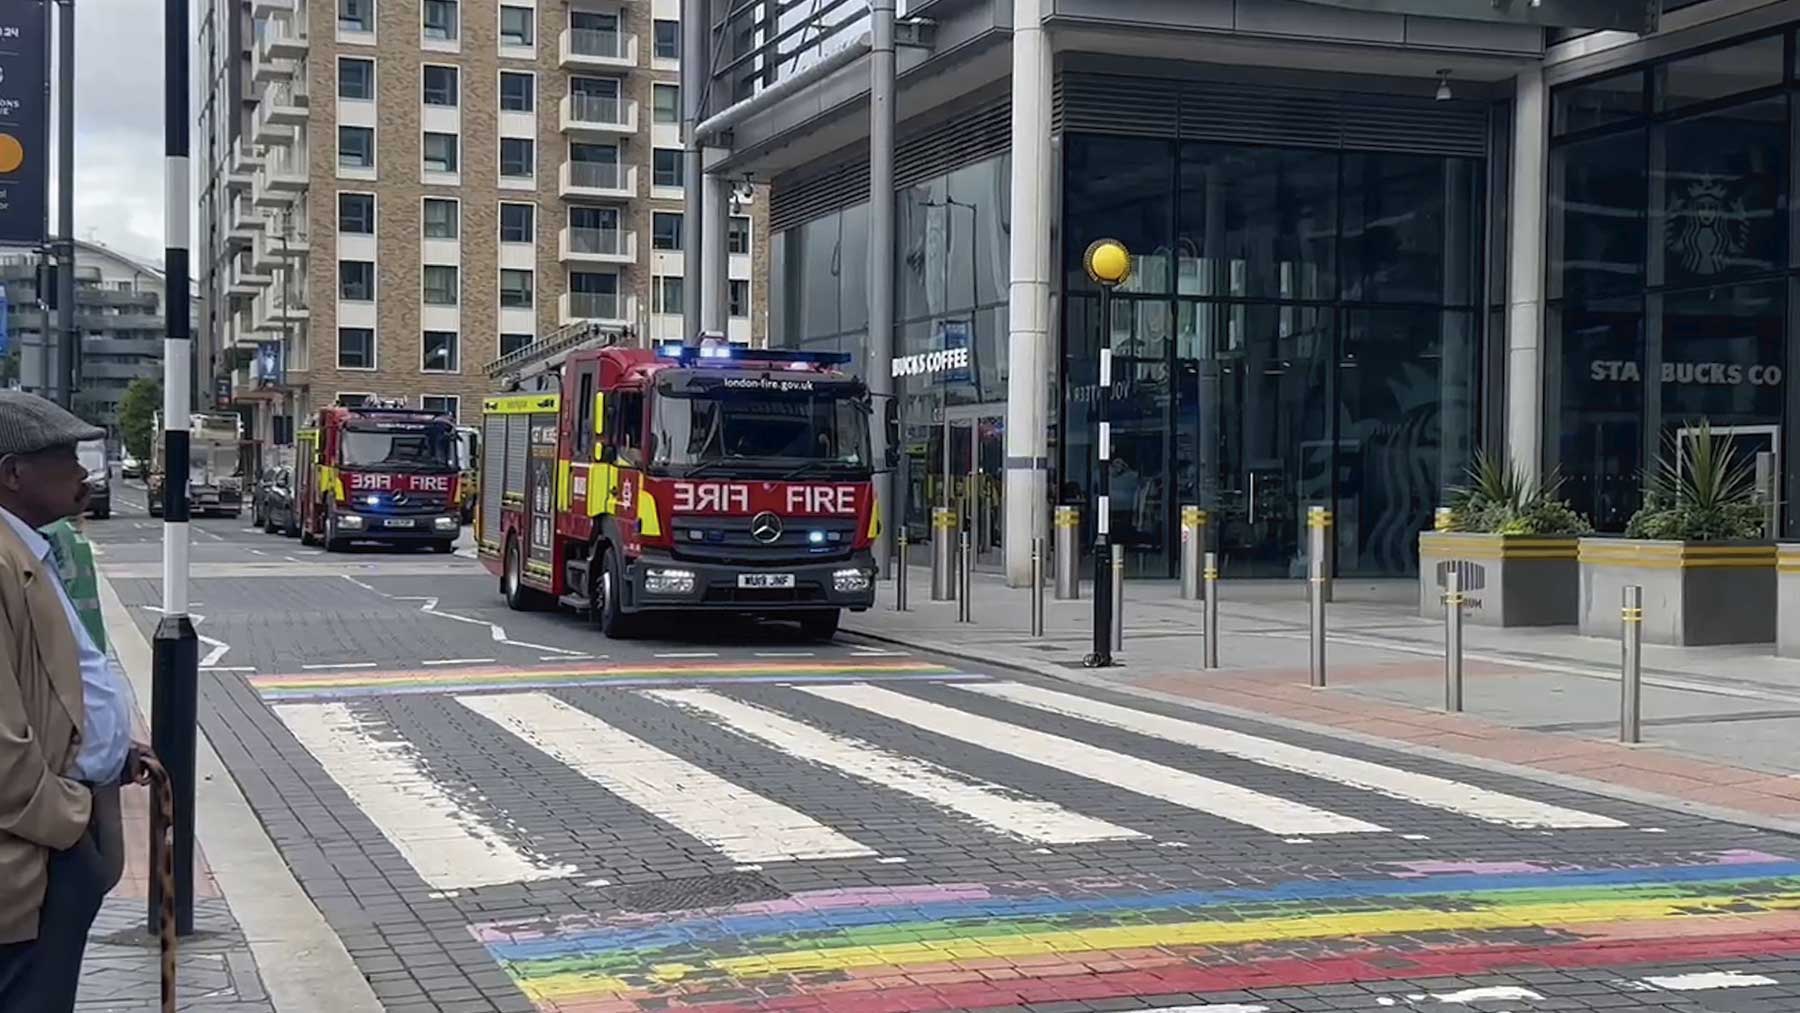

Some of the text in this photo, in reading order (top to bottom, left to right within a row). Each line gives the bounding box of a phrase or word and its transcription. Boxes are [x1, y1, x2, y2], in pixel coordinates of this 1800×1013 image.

[927, 347, 968, 373] COFFEE
[1590, 360, 1741, 386] STABUCKS
[723, 377, 814, 392] london-fire.gov.uk
[410, 475, 448, 490] FIRE
[786, 486, 855, 513] FIRE
